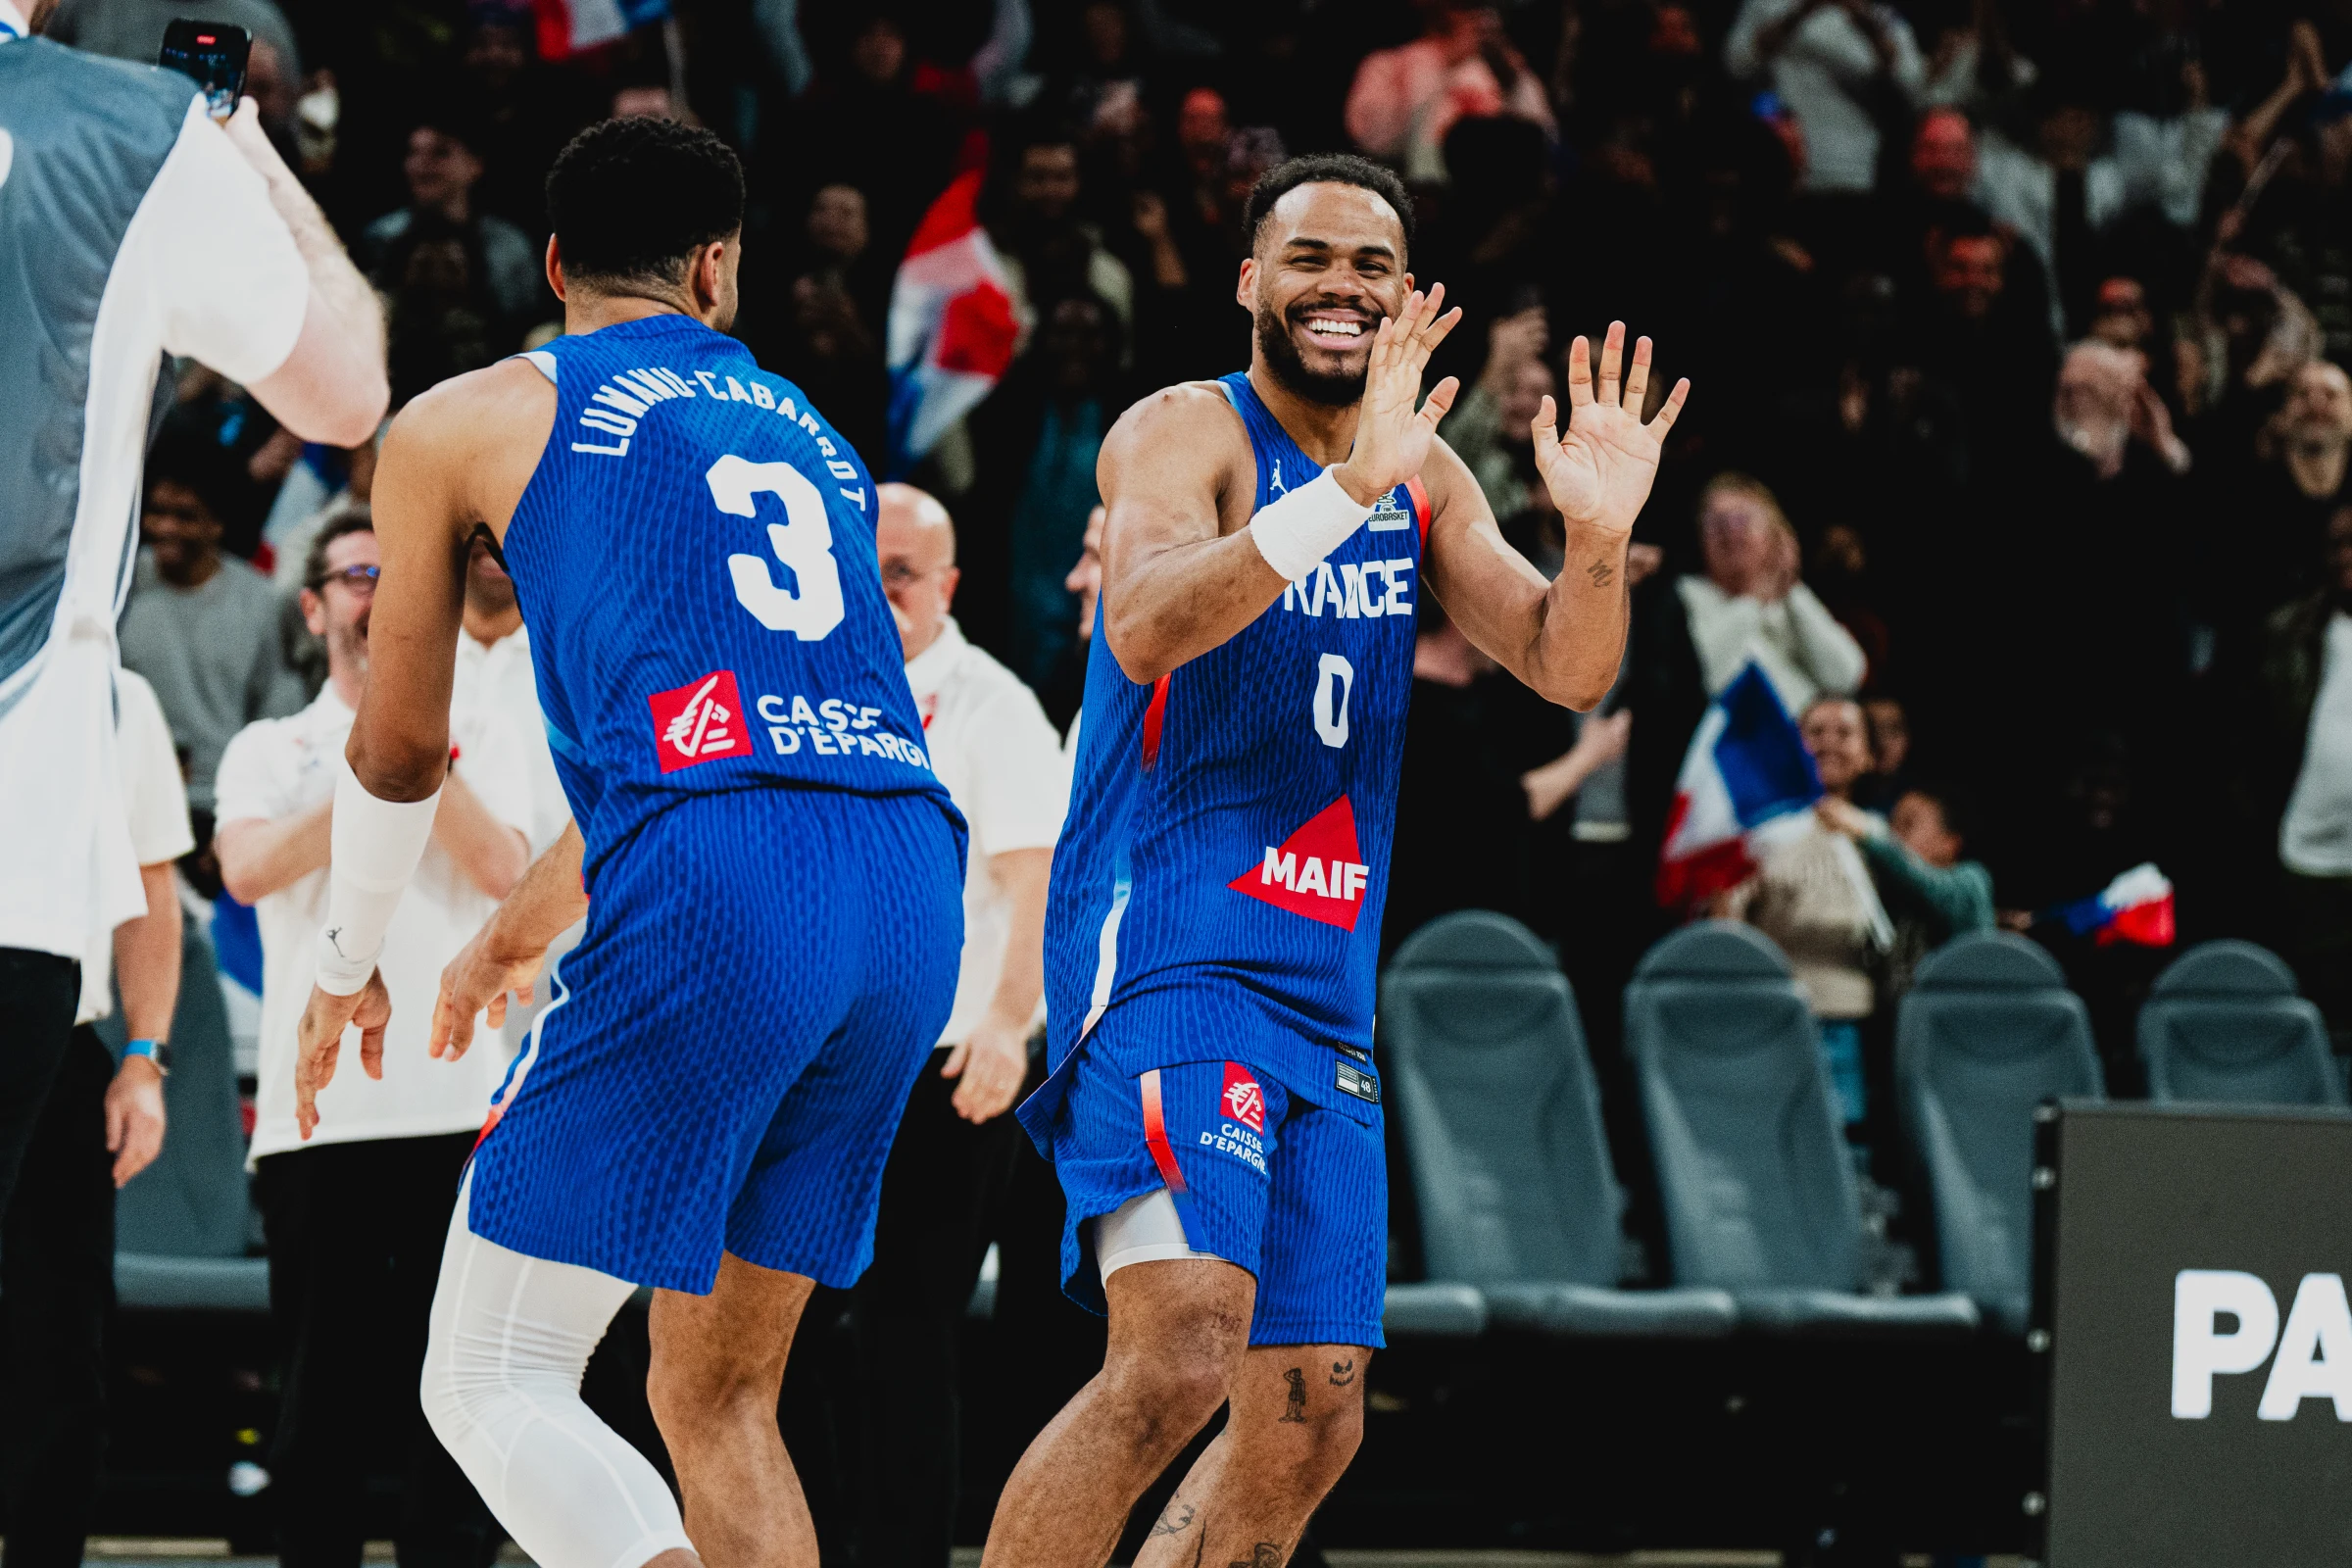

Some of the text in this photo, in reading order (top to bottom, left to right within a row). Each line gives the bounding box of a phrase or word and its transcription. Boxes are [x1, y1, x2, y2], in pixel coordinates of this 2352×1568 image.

[706, 455, 846, 641] 3
[1284, 557, 1413, 618] RANCE
[1313, 653, 1353, 749] 0
[768, 726, 930, 770] D'EPARG
[1261, 846, 1369, 901] MAIF
[1360, 1080, 1371, 1093] 48
[1221, 1123, 1263, 1153] CAISSE
[2171, 1269, 2352, 1421] PA
